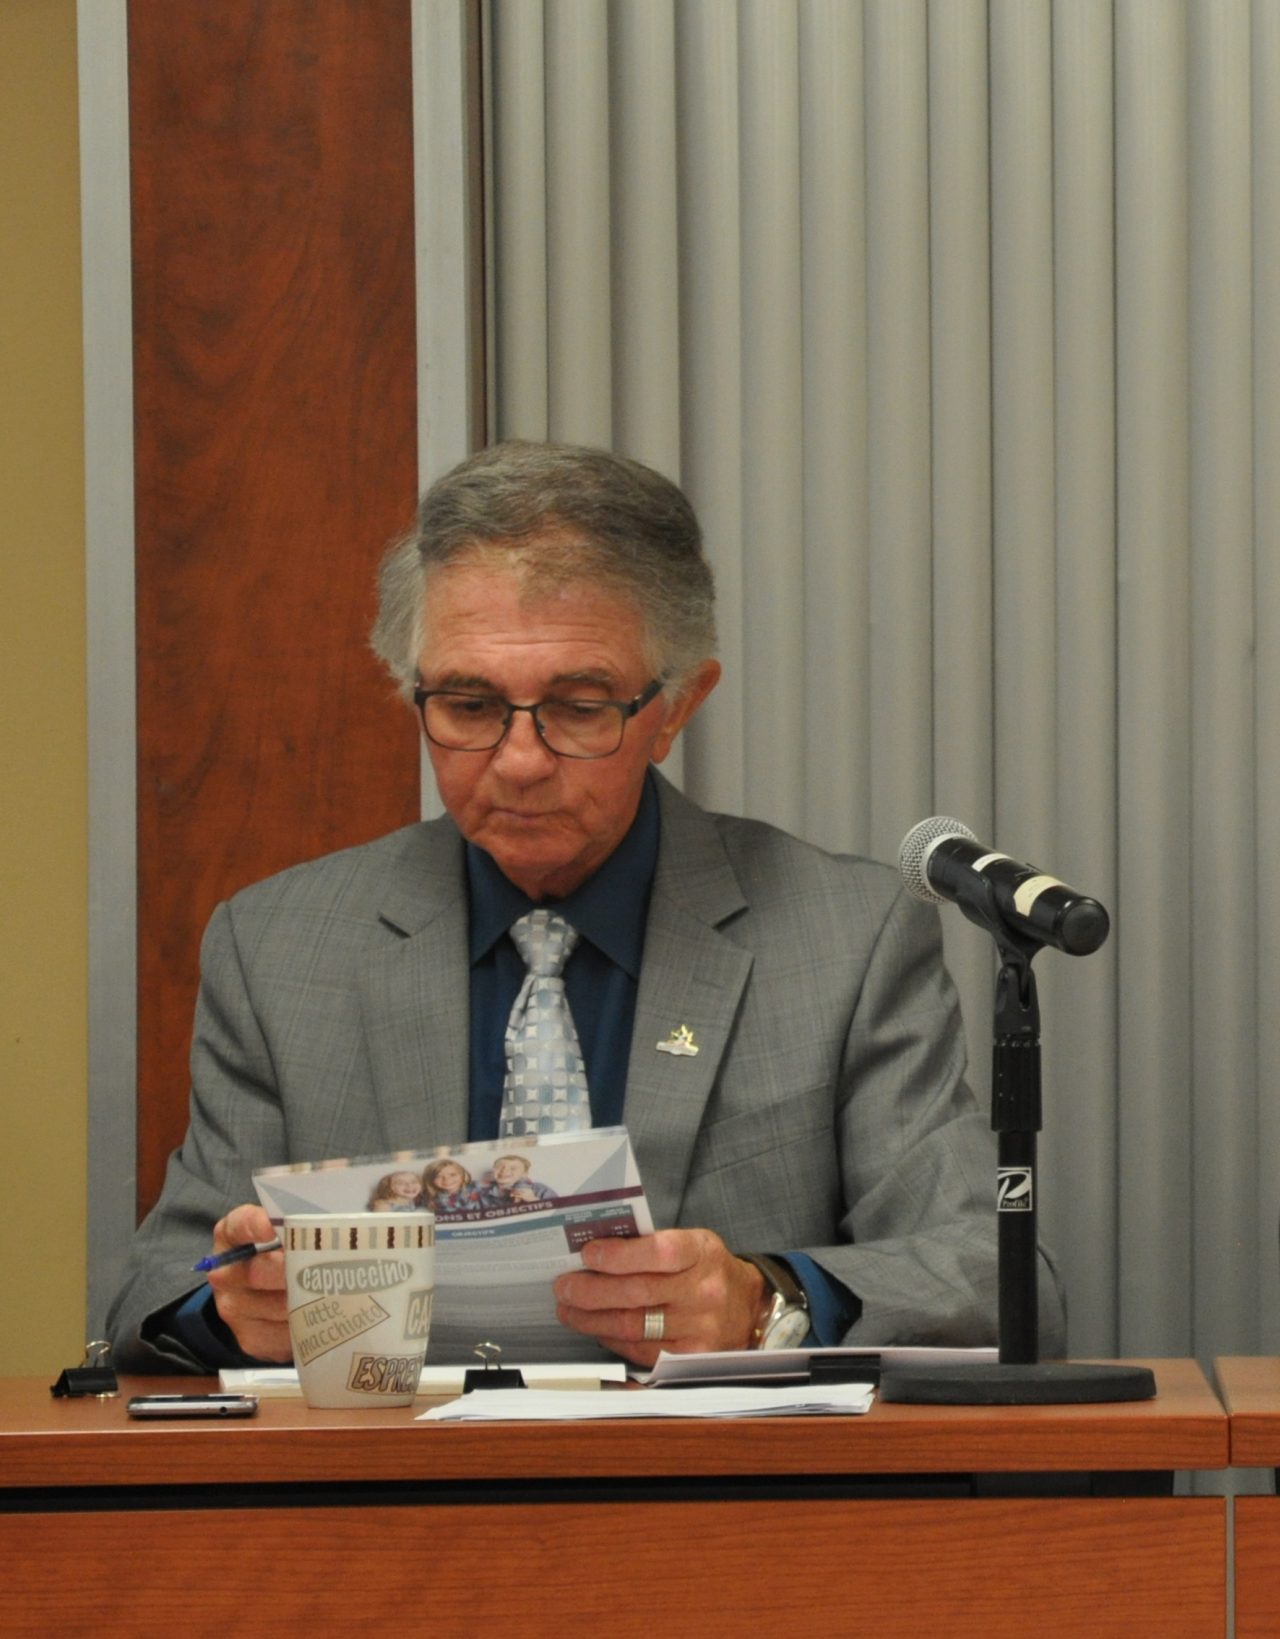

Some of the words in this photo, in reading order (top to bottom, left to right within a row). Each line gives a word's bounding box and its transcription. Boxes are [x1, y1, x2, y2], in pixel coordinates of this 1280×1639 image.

[466, 1212, 481, 1221] ET
[484, 1200, 554, 1218] OBJECTIFS
[302, 1258, 409, 1296] cappuccino
[303, 1300, 343, 1329] latte
[296, 1304, 383, 1359] macchiato
